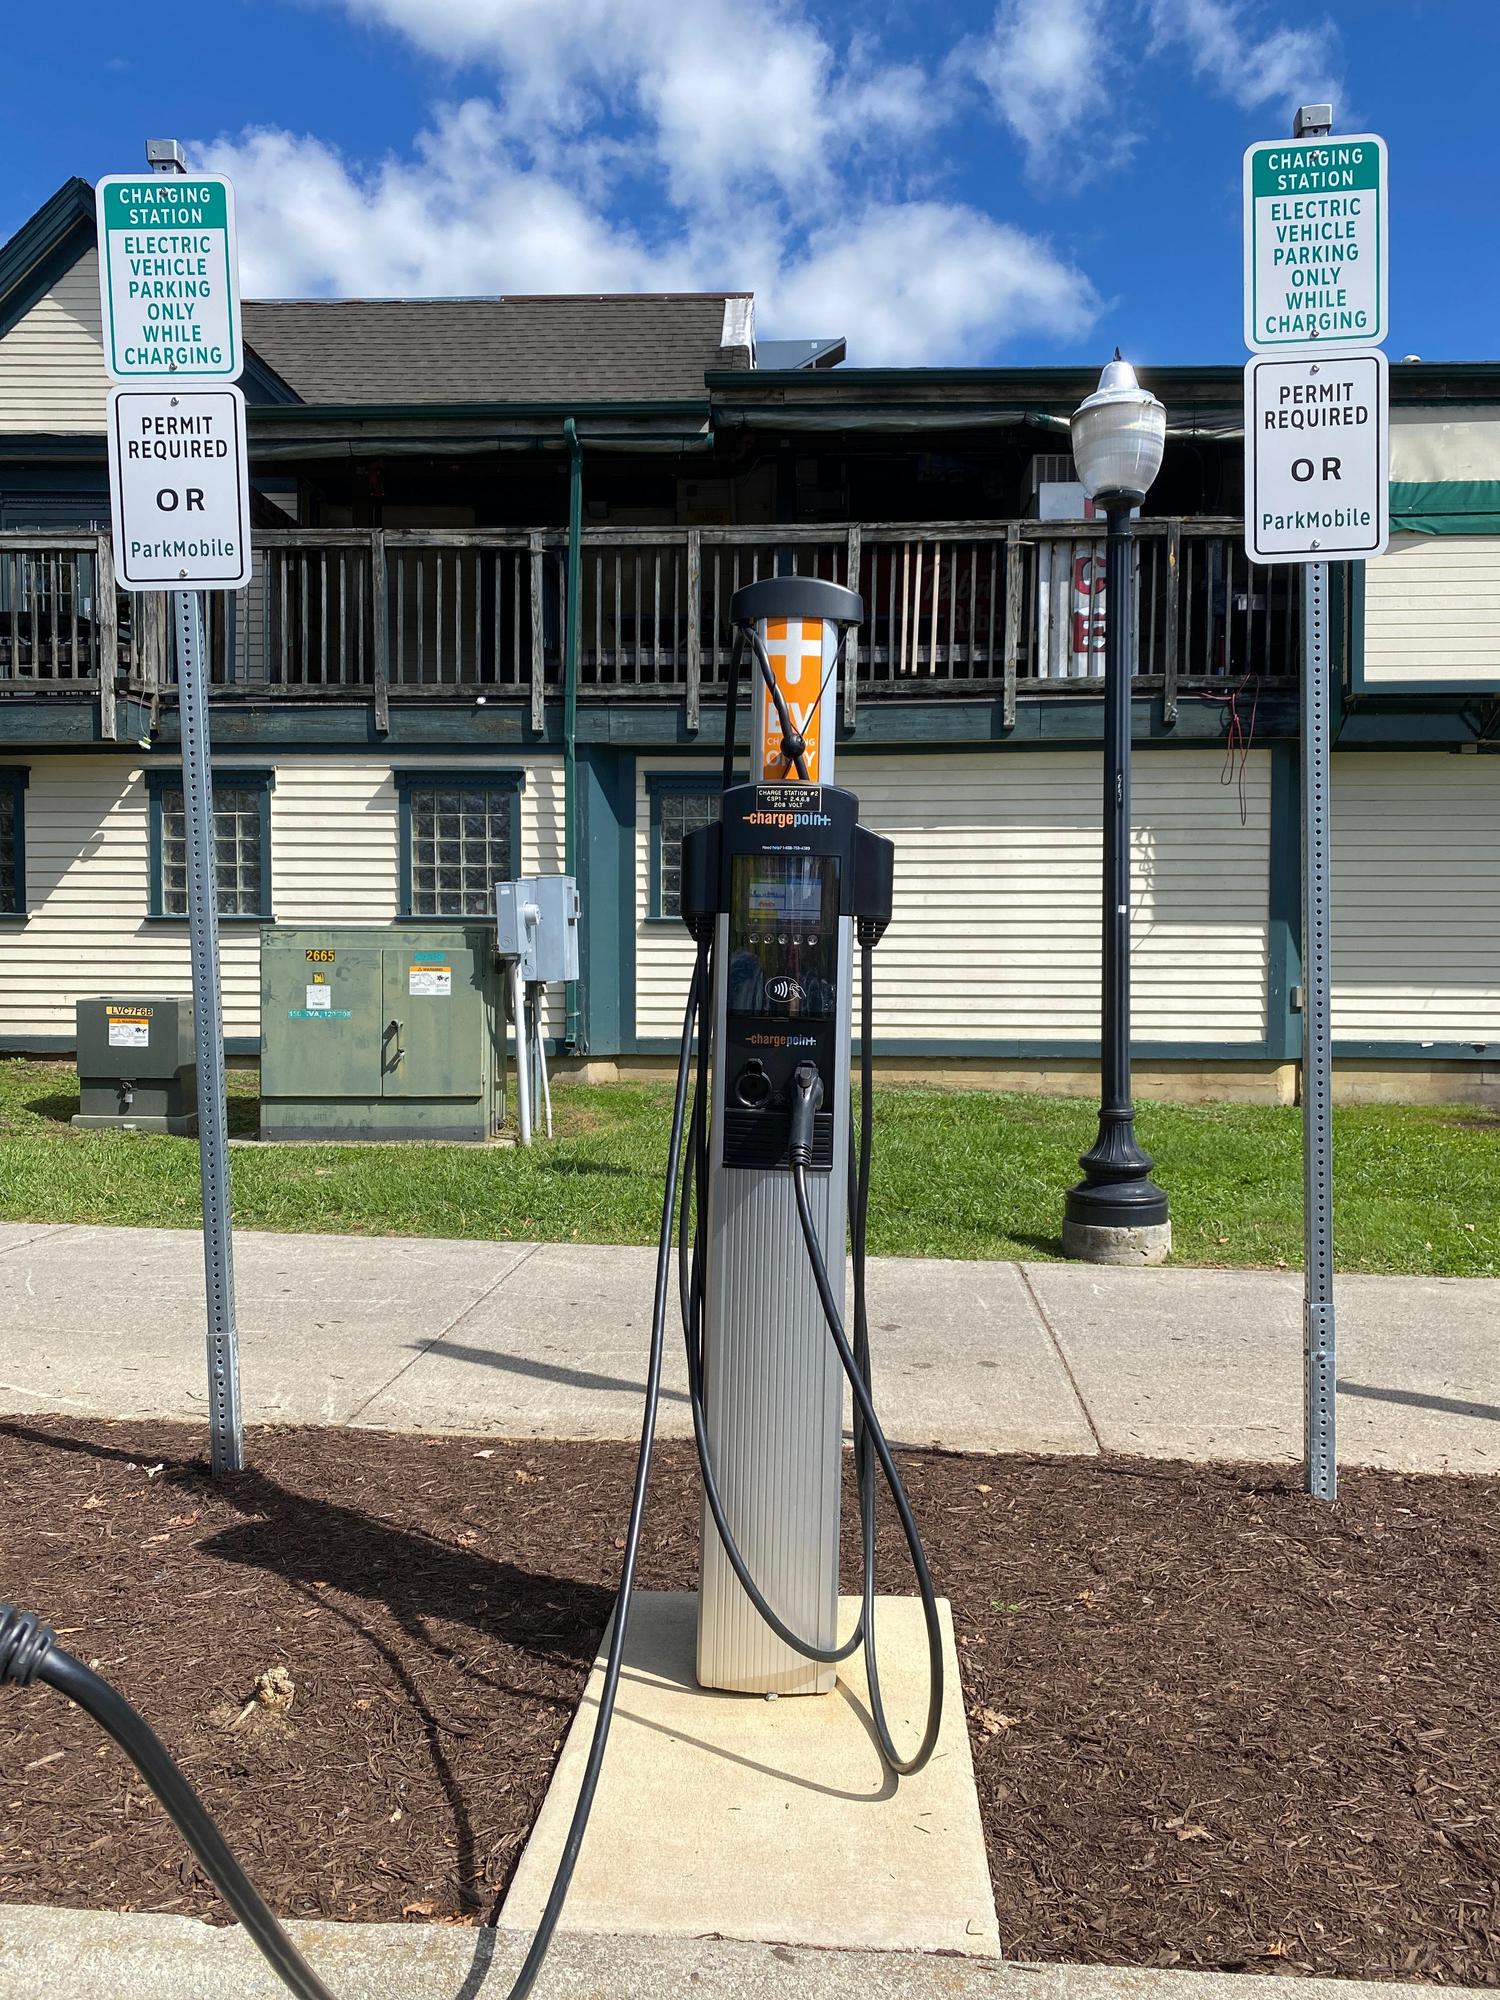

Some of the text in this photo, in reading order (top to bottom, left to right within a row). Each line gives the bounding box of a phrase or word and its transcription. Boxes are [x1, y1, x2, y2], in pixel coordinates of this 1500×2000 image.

[1268, 148, 1364, 170] CHARGING
[1277, 170, 1354, 191] STATION
[119, 187, 211, 204] CHARGING
[129, 208, 203, 224] STATION
[1271, 197, 1361, 221] ELECTRIC
[1276, 220, 1356, 243] VEHICLE
[124, 236, 211, 254] ELECTRIC
[1273, 243, 1359, 266] PARKING
[130, 258, 207, 276] VEHICLE
[1291, 267, 1342, 287] ONLY
[129, 280, 211, 298] PARKING
[1285, 289, 1347, 310] WHILE
[147, 303, 195, 320] ONLY
[1265, 310, 1367, 334] CHARGING
[142, 324, 202, 343] WHILE
[124, 347, 222, 365] CHARGING
[1279, 382, 1354, 405] PERMIT
[141, 416, 213, 435] PERMIT
[1264, 405, 1369, 430] REQUIRED
[128, 439, 228, 460] REQUIRED
[1290, 456, 1342, 482] OR
[156, 488, 205, 512] OR
[1263, 508, 1371, 530] ParkMobile
[131, 538, 234, 558] ParkMobile
[305, 950, 335, 961] 2665
[111, 1007, 153, 1016] LVC7F6B
